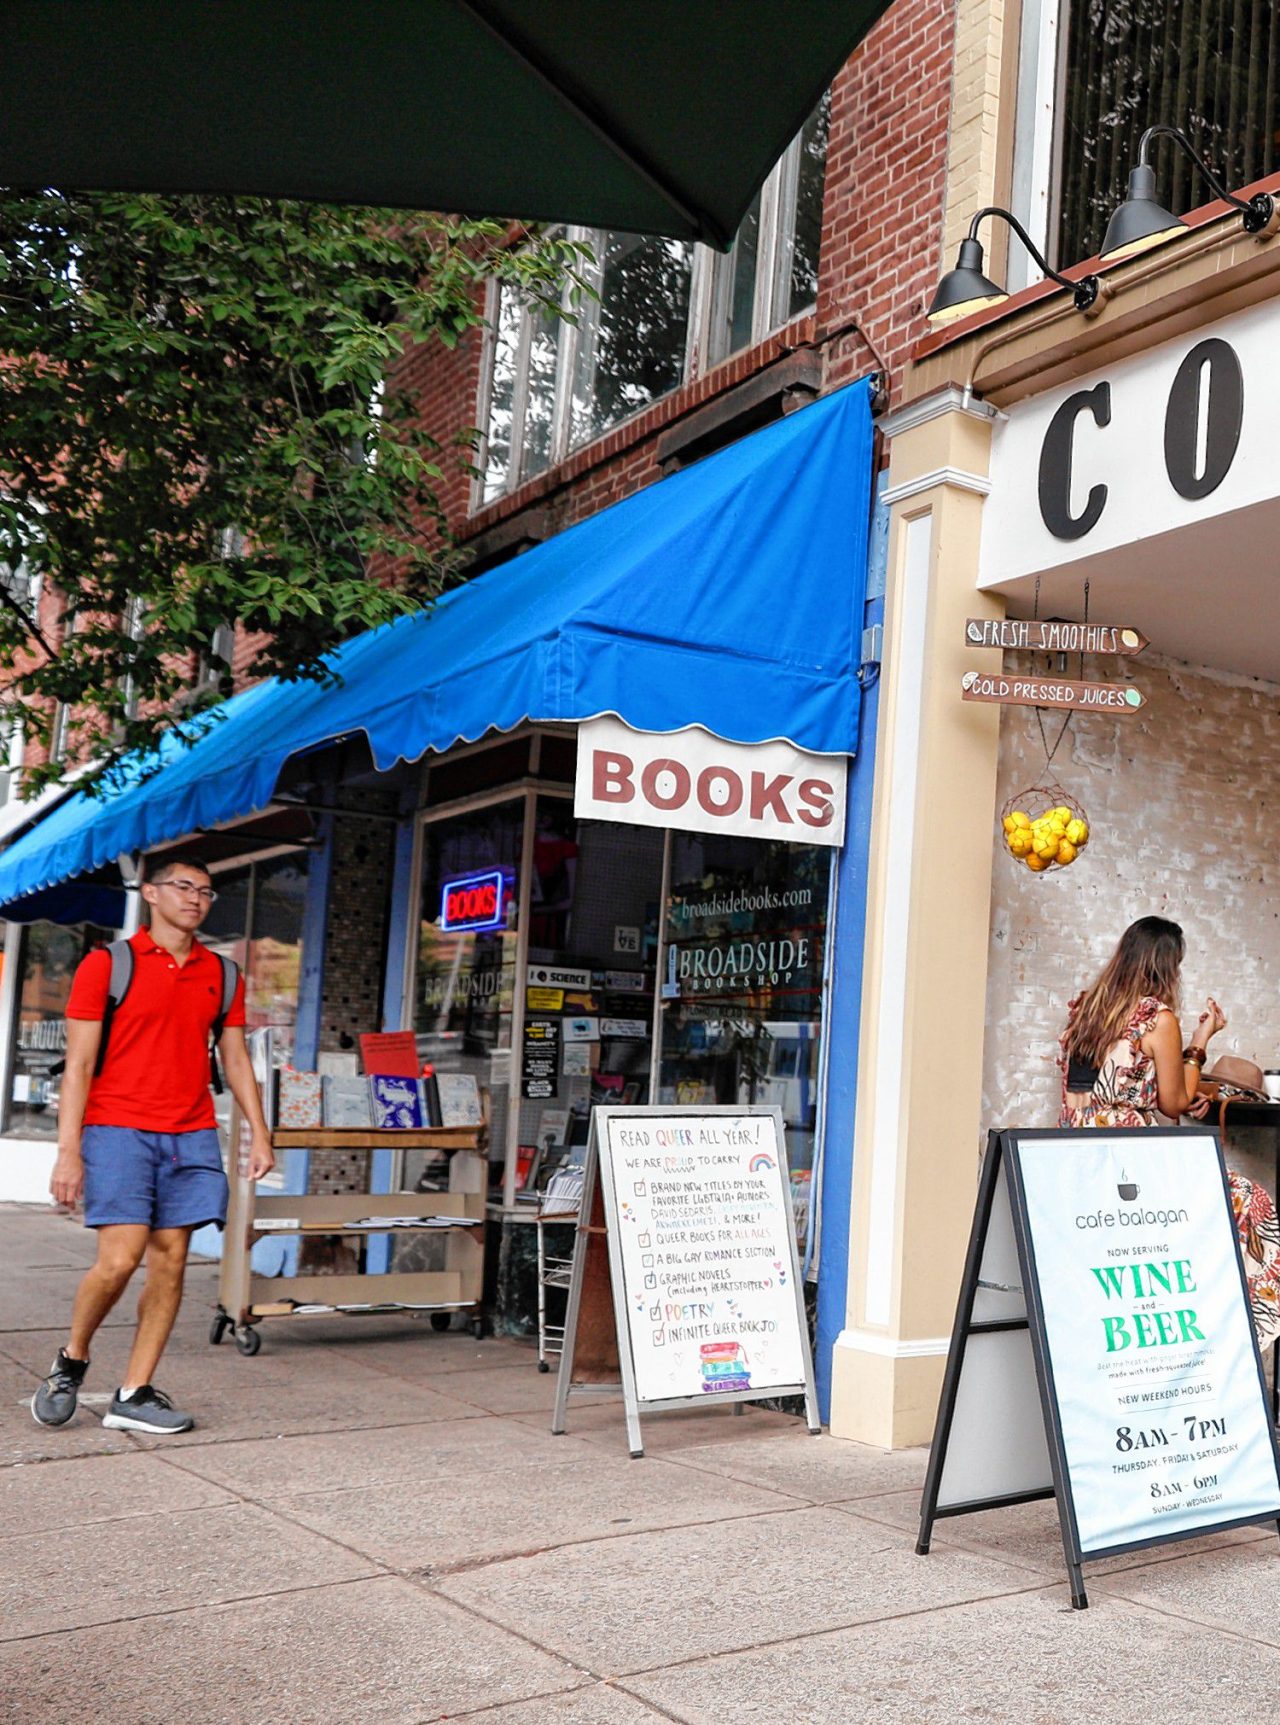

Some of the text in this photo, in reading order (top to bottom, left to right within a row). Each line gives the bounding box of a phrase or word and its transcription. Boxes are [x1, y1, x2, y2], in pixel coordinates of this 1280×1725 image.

[982, 620, 1118, 652] FRESH SMOOTHIES
[972, 679, 1126, 706] COLD PRESSED JUICES
[592, 749, 835, 828] BOOKS
[446, 884, 497, 921] BOOKS
[682, 885, 812, 919] broadsidebooks.com
[680, 938, 810, 979] BROADSIDE
[550, 971, 587, 984] SCIENCE
[692, 971, 793, 990] BOOKSHOP
[620, 1124, 760, 1147] READ QUEER ALL YEAR!
[625, 1157, 640, 1168] WE
[643, 1157, 662, 1168] ARE
[698, 1156, 710, 1165] TO
[711, 1155, 741, 1165] CARRY
[651, 1180, 766, 1195] BRAND NEW TITLES BY YOUR
[652, 1194, 689, 1206] FAVORITE
[651, 1208, 678, 1220] DAVID
[1075, 1208, 1189, 1230] cafe balagan
[656, 1232, 686, 1245] QUEER
[690, 1231, 715, 1243] BOOKS
[718, 1230, 733, 1240] FOR
[656, 1245, 776, 1264] A BIG GAY ROMANCE SECTION
[1107, 1244, 1169, 1257] NOW SERVING
[659, 1269, 731, 1285] GRAPHIC NOVELS
[1089, 1259, 1197, 1300] WINE
[665, 1303, 714, 1321] POETRY
[1141, 1301, 1156, 1310] and
[669, 1324, 710, 1343] INFINITE
[713, 1321, 737, 1336] QUEER
[739, 1320, 760, 1332] BOOK
[1101, 1309, 1206, 1353] BEER
[1108, 1369, 1127, 1379] made
[1129, 1366, 1144, 1375] with
[1118, 1383, 1212, 1405] NEW WEEKEND HOURS
[1115, 1426, 1169, 1452] 8AM
[1184, 1416, 1227, 1442] 7PM
[1163, 1454, 1189, 1465] FRIDAY
[1197, 1444, 1239, 1461] SATURDAY
[1150, 1482, 1182, 1498] 8AM
[1193, 1474, 1218, 1489] 6PM
[1152, 1503, 1180, 1514] SUNDAY
[1186, 1493, 1223, 1508] WEDNESDAY
